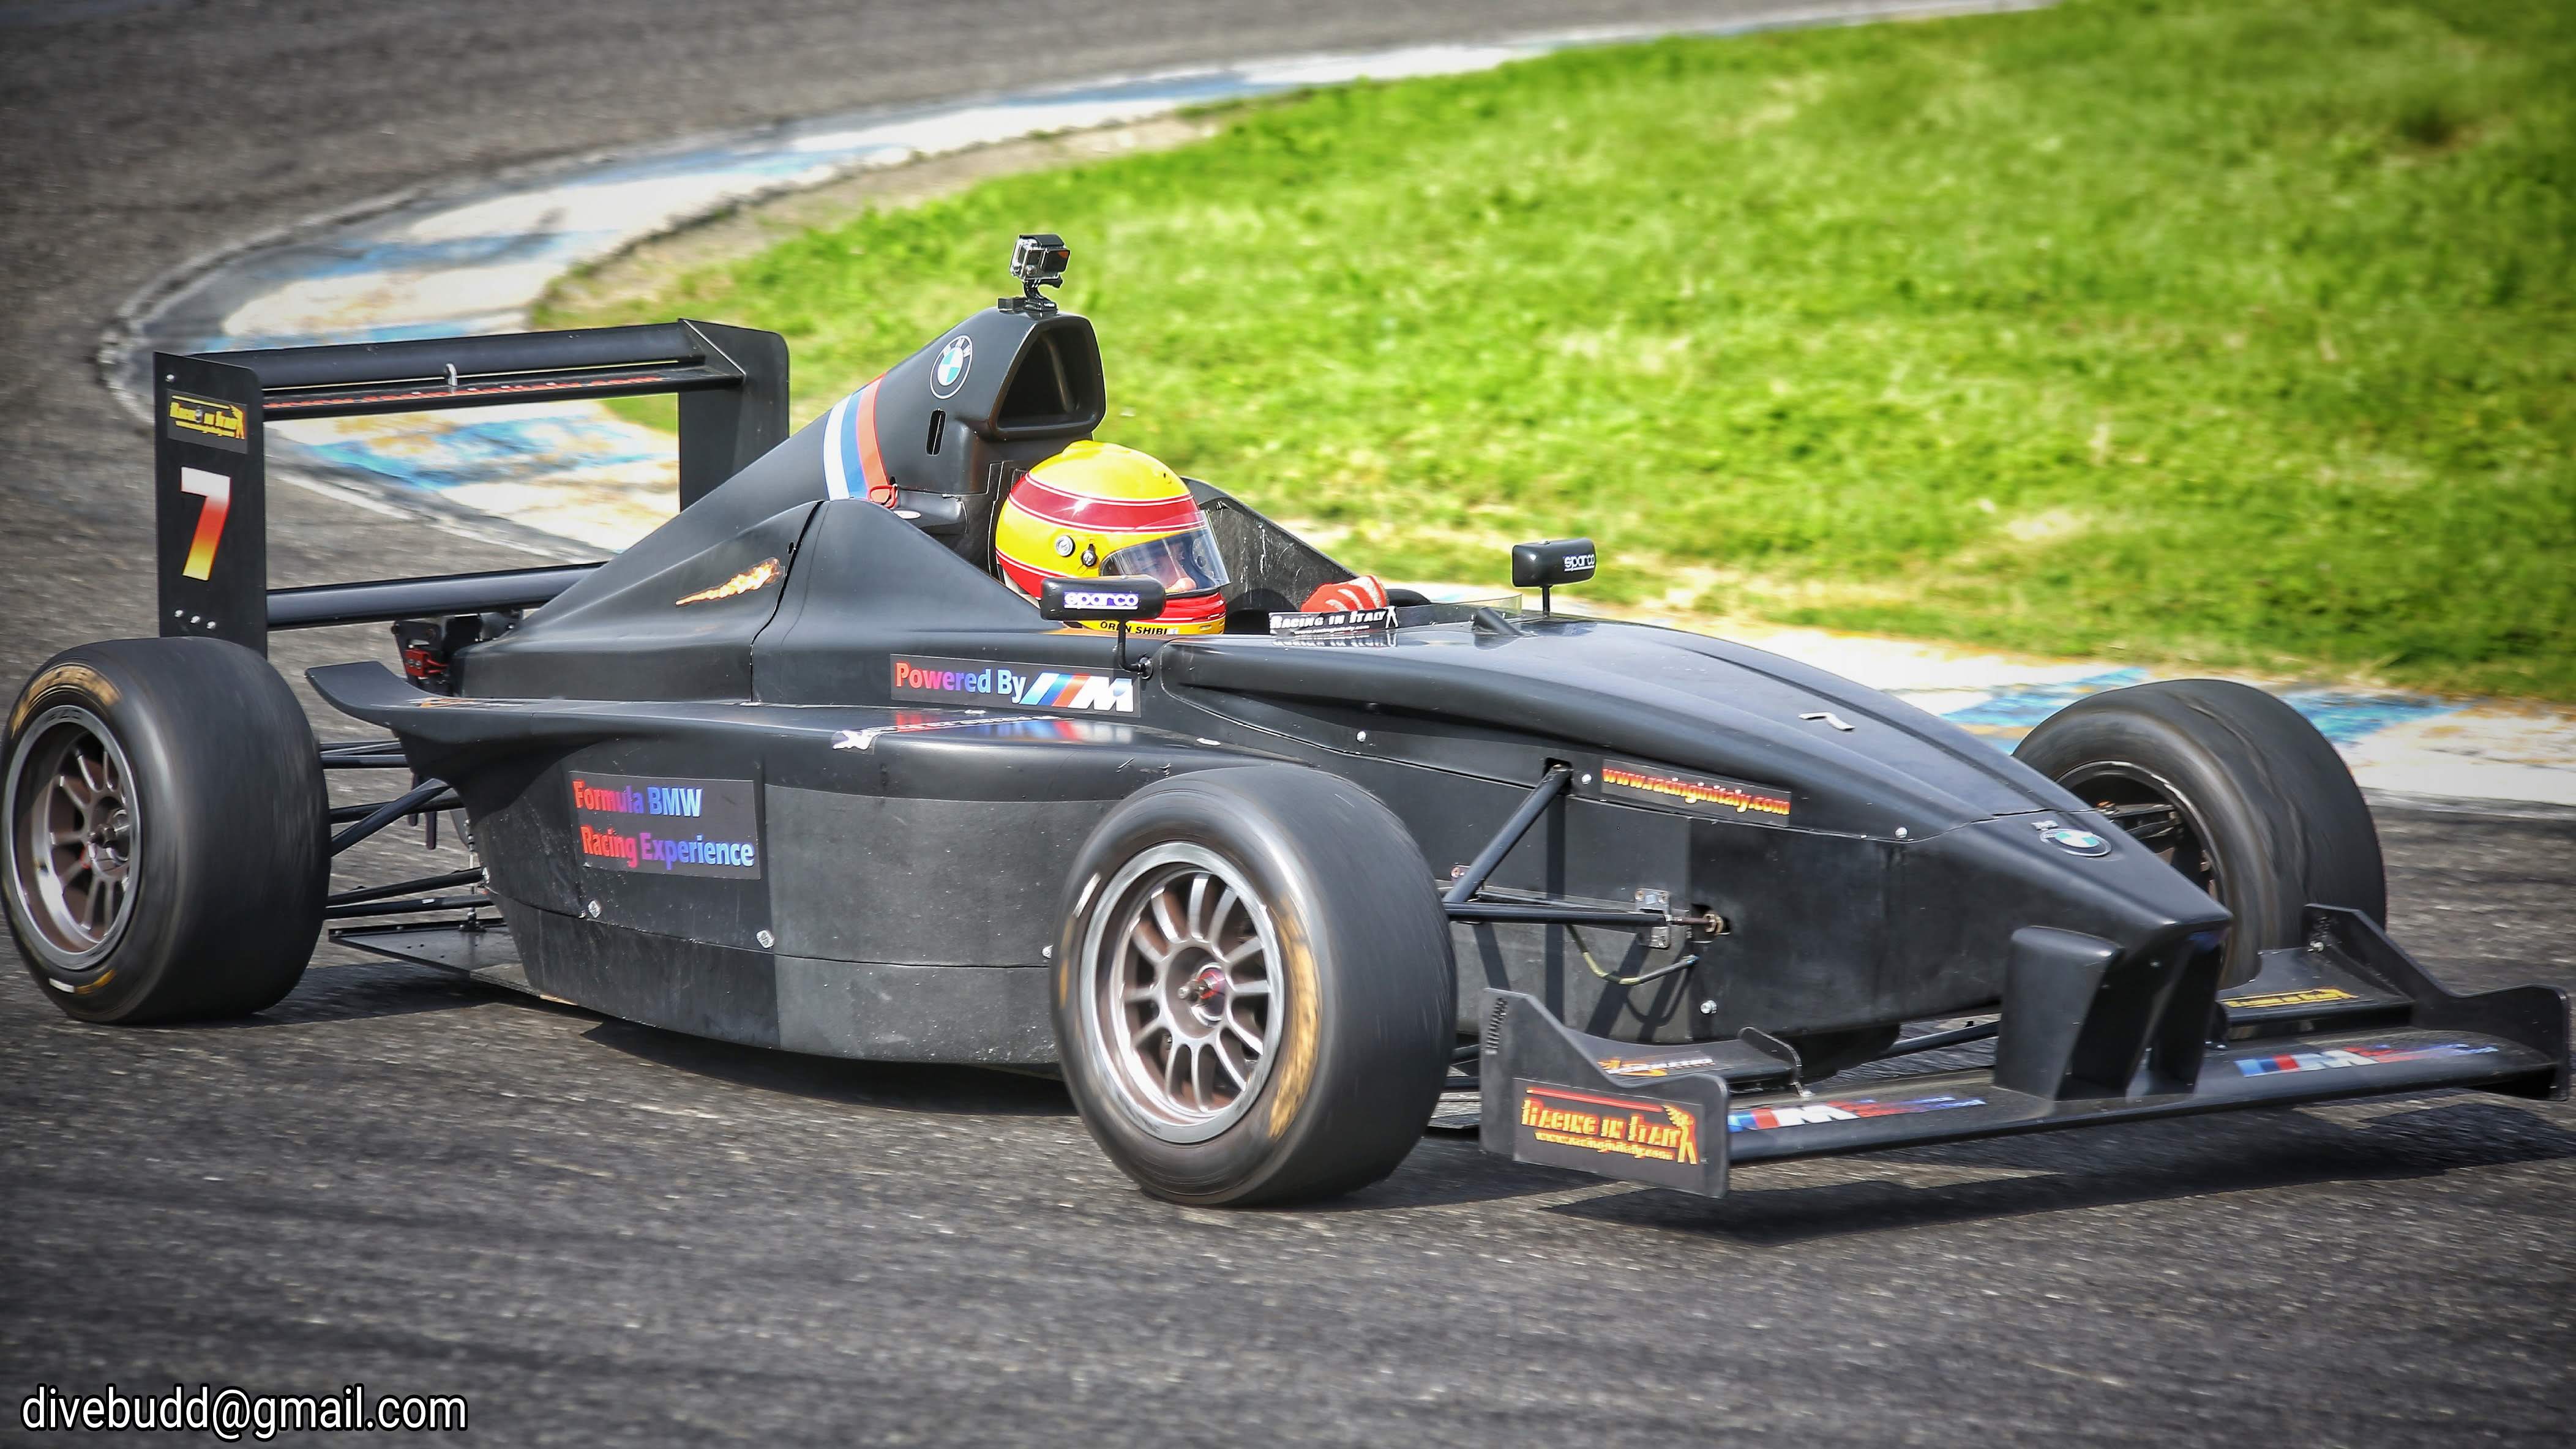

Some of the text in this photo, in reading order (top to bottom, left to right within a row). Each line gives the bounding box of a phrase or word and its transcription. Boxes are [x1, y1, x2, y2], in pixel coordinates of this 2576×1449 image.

[181, 466, 231, 581] 7
[1564, 554, 1595, 571] sparco
[1064, 593, 1139, 610] sparco
[895, 662, 992, 694] Powered
[997, 669, 1027, 704] By
[572, 779, 703, 818] Formula BMW
[1602, 768, 1791, 815] www.racinginitaly.com
[580, 825, 755, 871] Racing Experience
